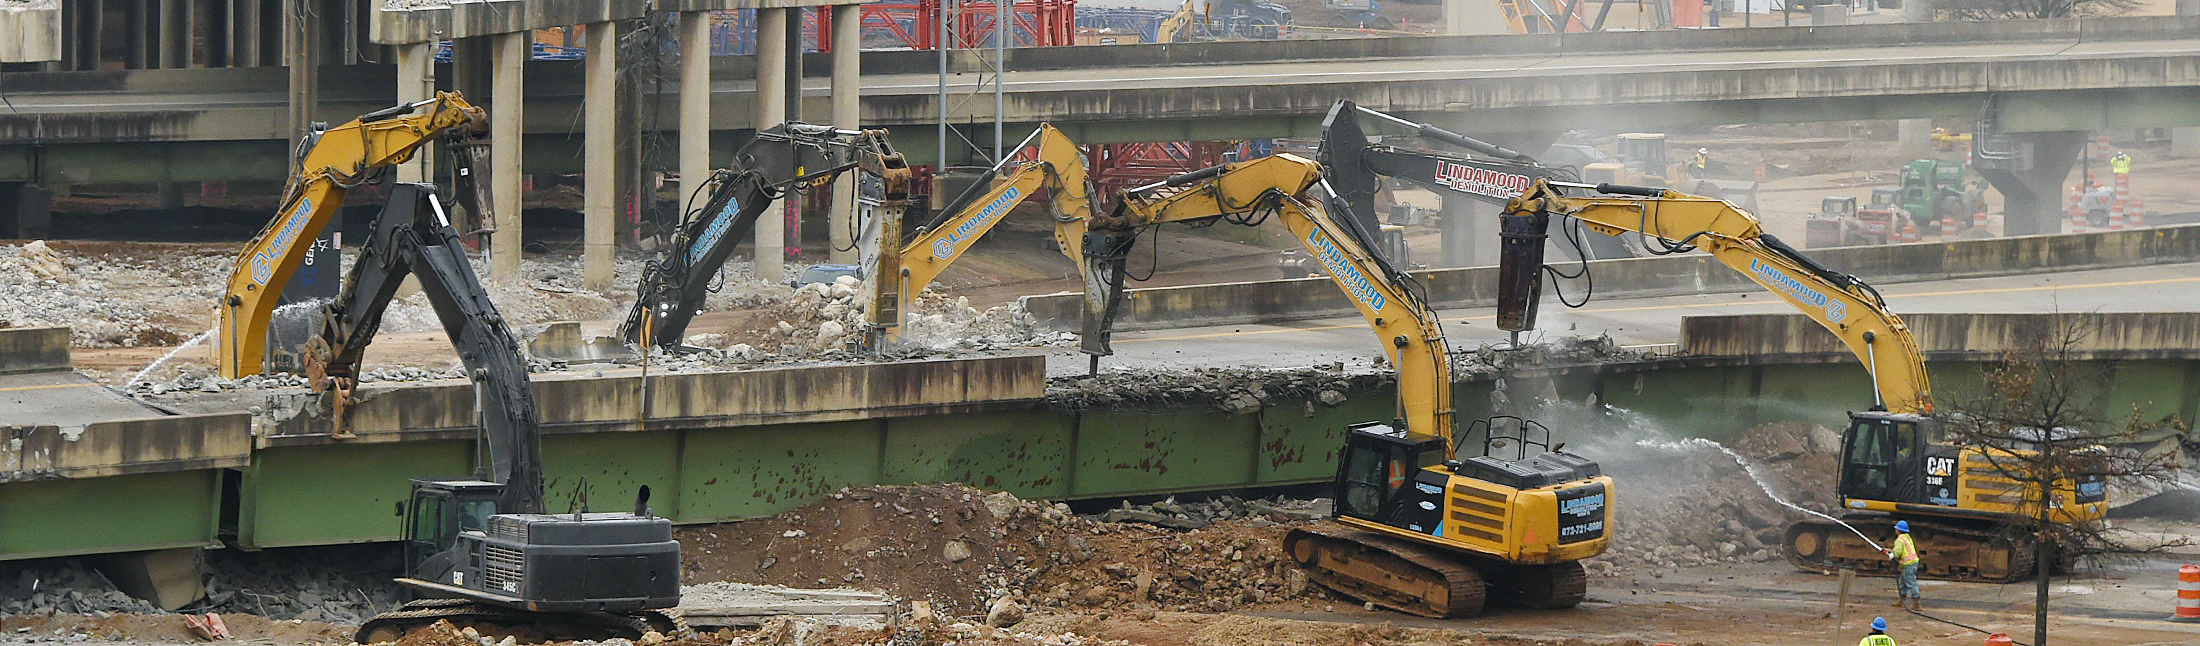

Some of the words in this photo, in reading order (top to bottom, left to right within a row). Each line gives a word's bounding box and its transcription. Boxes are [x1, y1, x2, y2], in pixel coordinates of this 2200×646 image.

[1435, 160, 1530, 194] LINDAMOOD
[1450, 180, 1511, 199] DEMOLITION
[266, 197, 313, 261] LINDAMOOD
[948, 186, 1020, 245] LINDAMOOD
[1307, 226, 1386, 311] LINDAMOOD
[1317, 250, 1367, 304] DEMOLITION
[1750, 258, 1827, 308] LINDAMOOD
[1927, 456, 1955, 476] CAT
[453, 571, 463, 586] CAT
